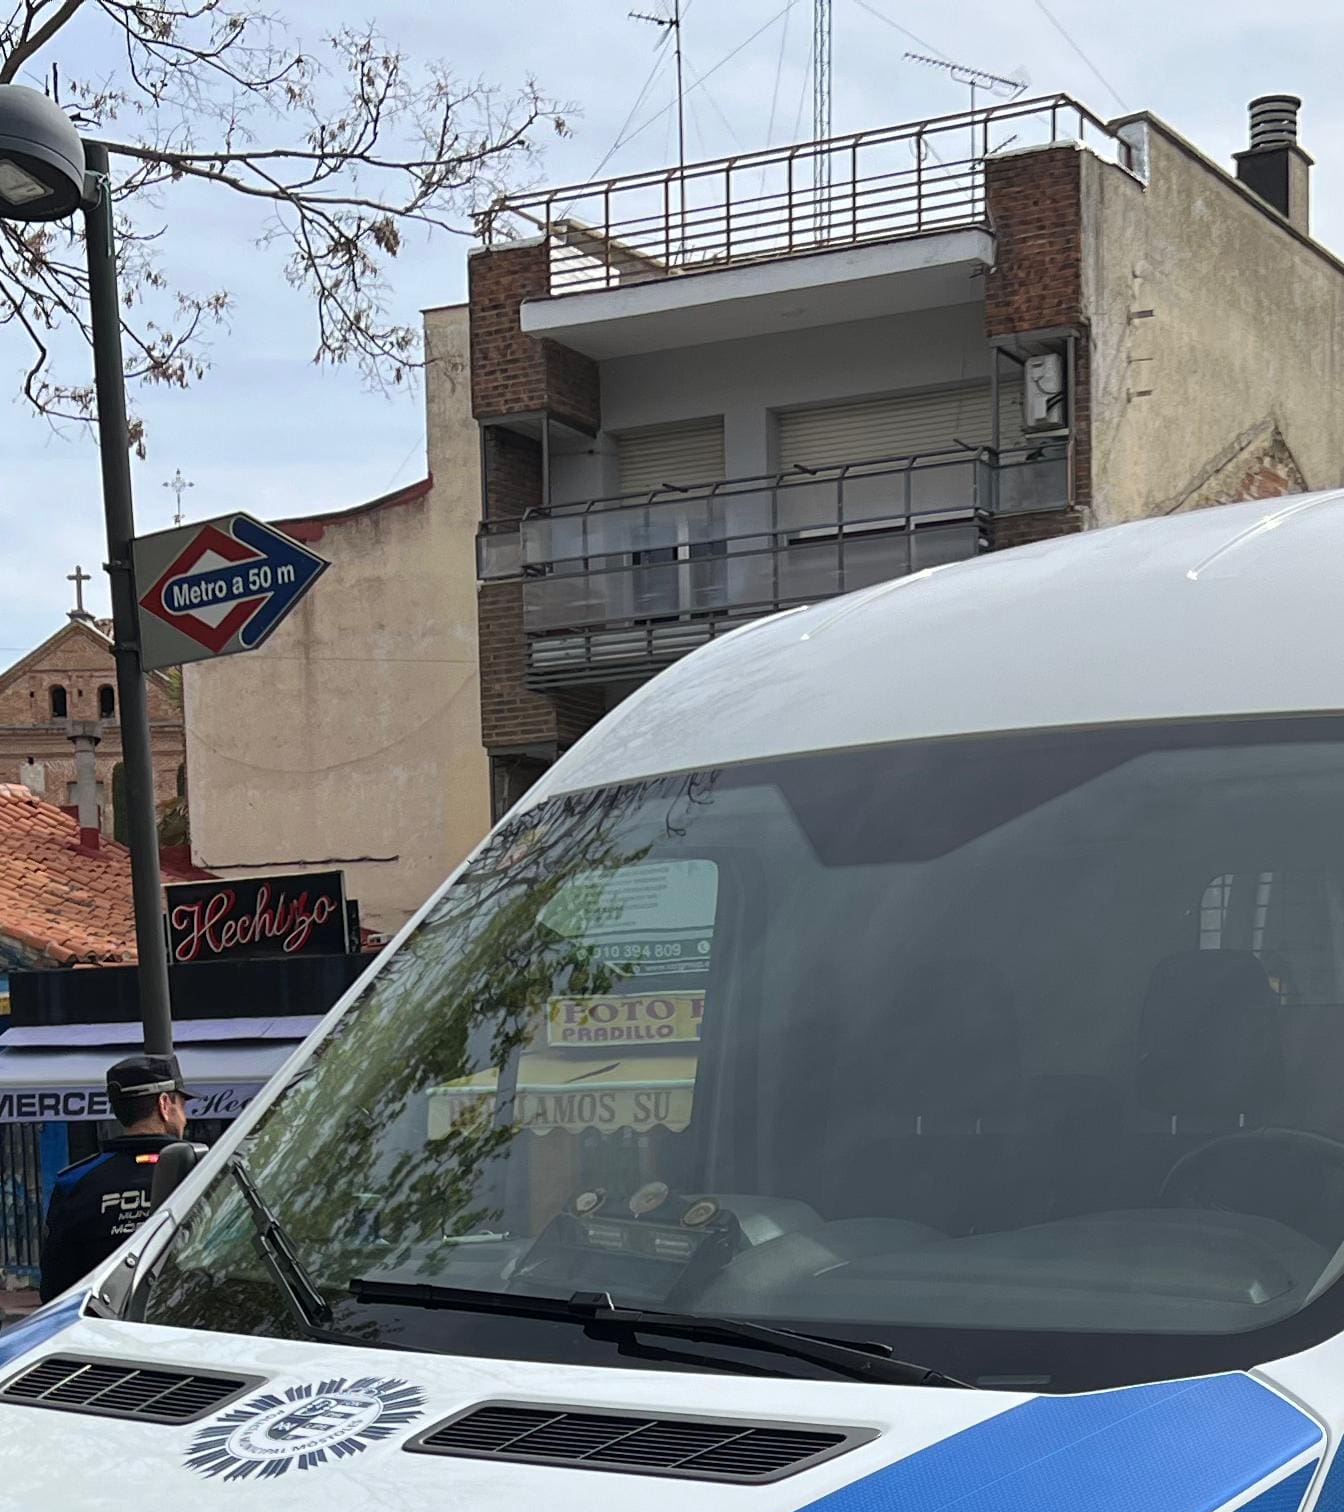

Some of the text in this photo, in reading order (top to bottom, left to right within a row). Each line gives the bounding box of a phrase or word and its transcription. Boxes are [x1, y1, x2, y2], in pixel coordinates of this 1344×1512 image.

[173, 563, 295, 608] Metro a 50 m
[171, 882, 338, 962] Hechizo
[624, 944, 651, 958] 394
[654, 943, 682, 957] 809
[564, 1000, 676, 1025] FOTO
[562, 1024, 675, 1041] PRADILLO
[632, 1092, 672, 1122] SU
